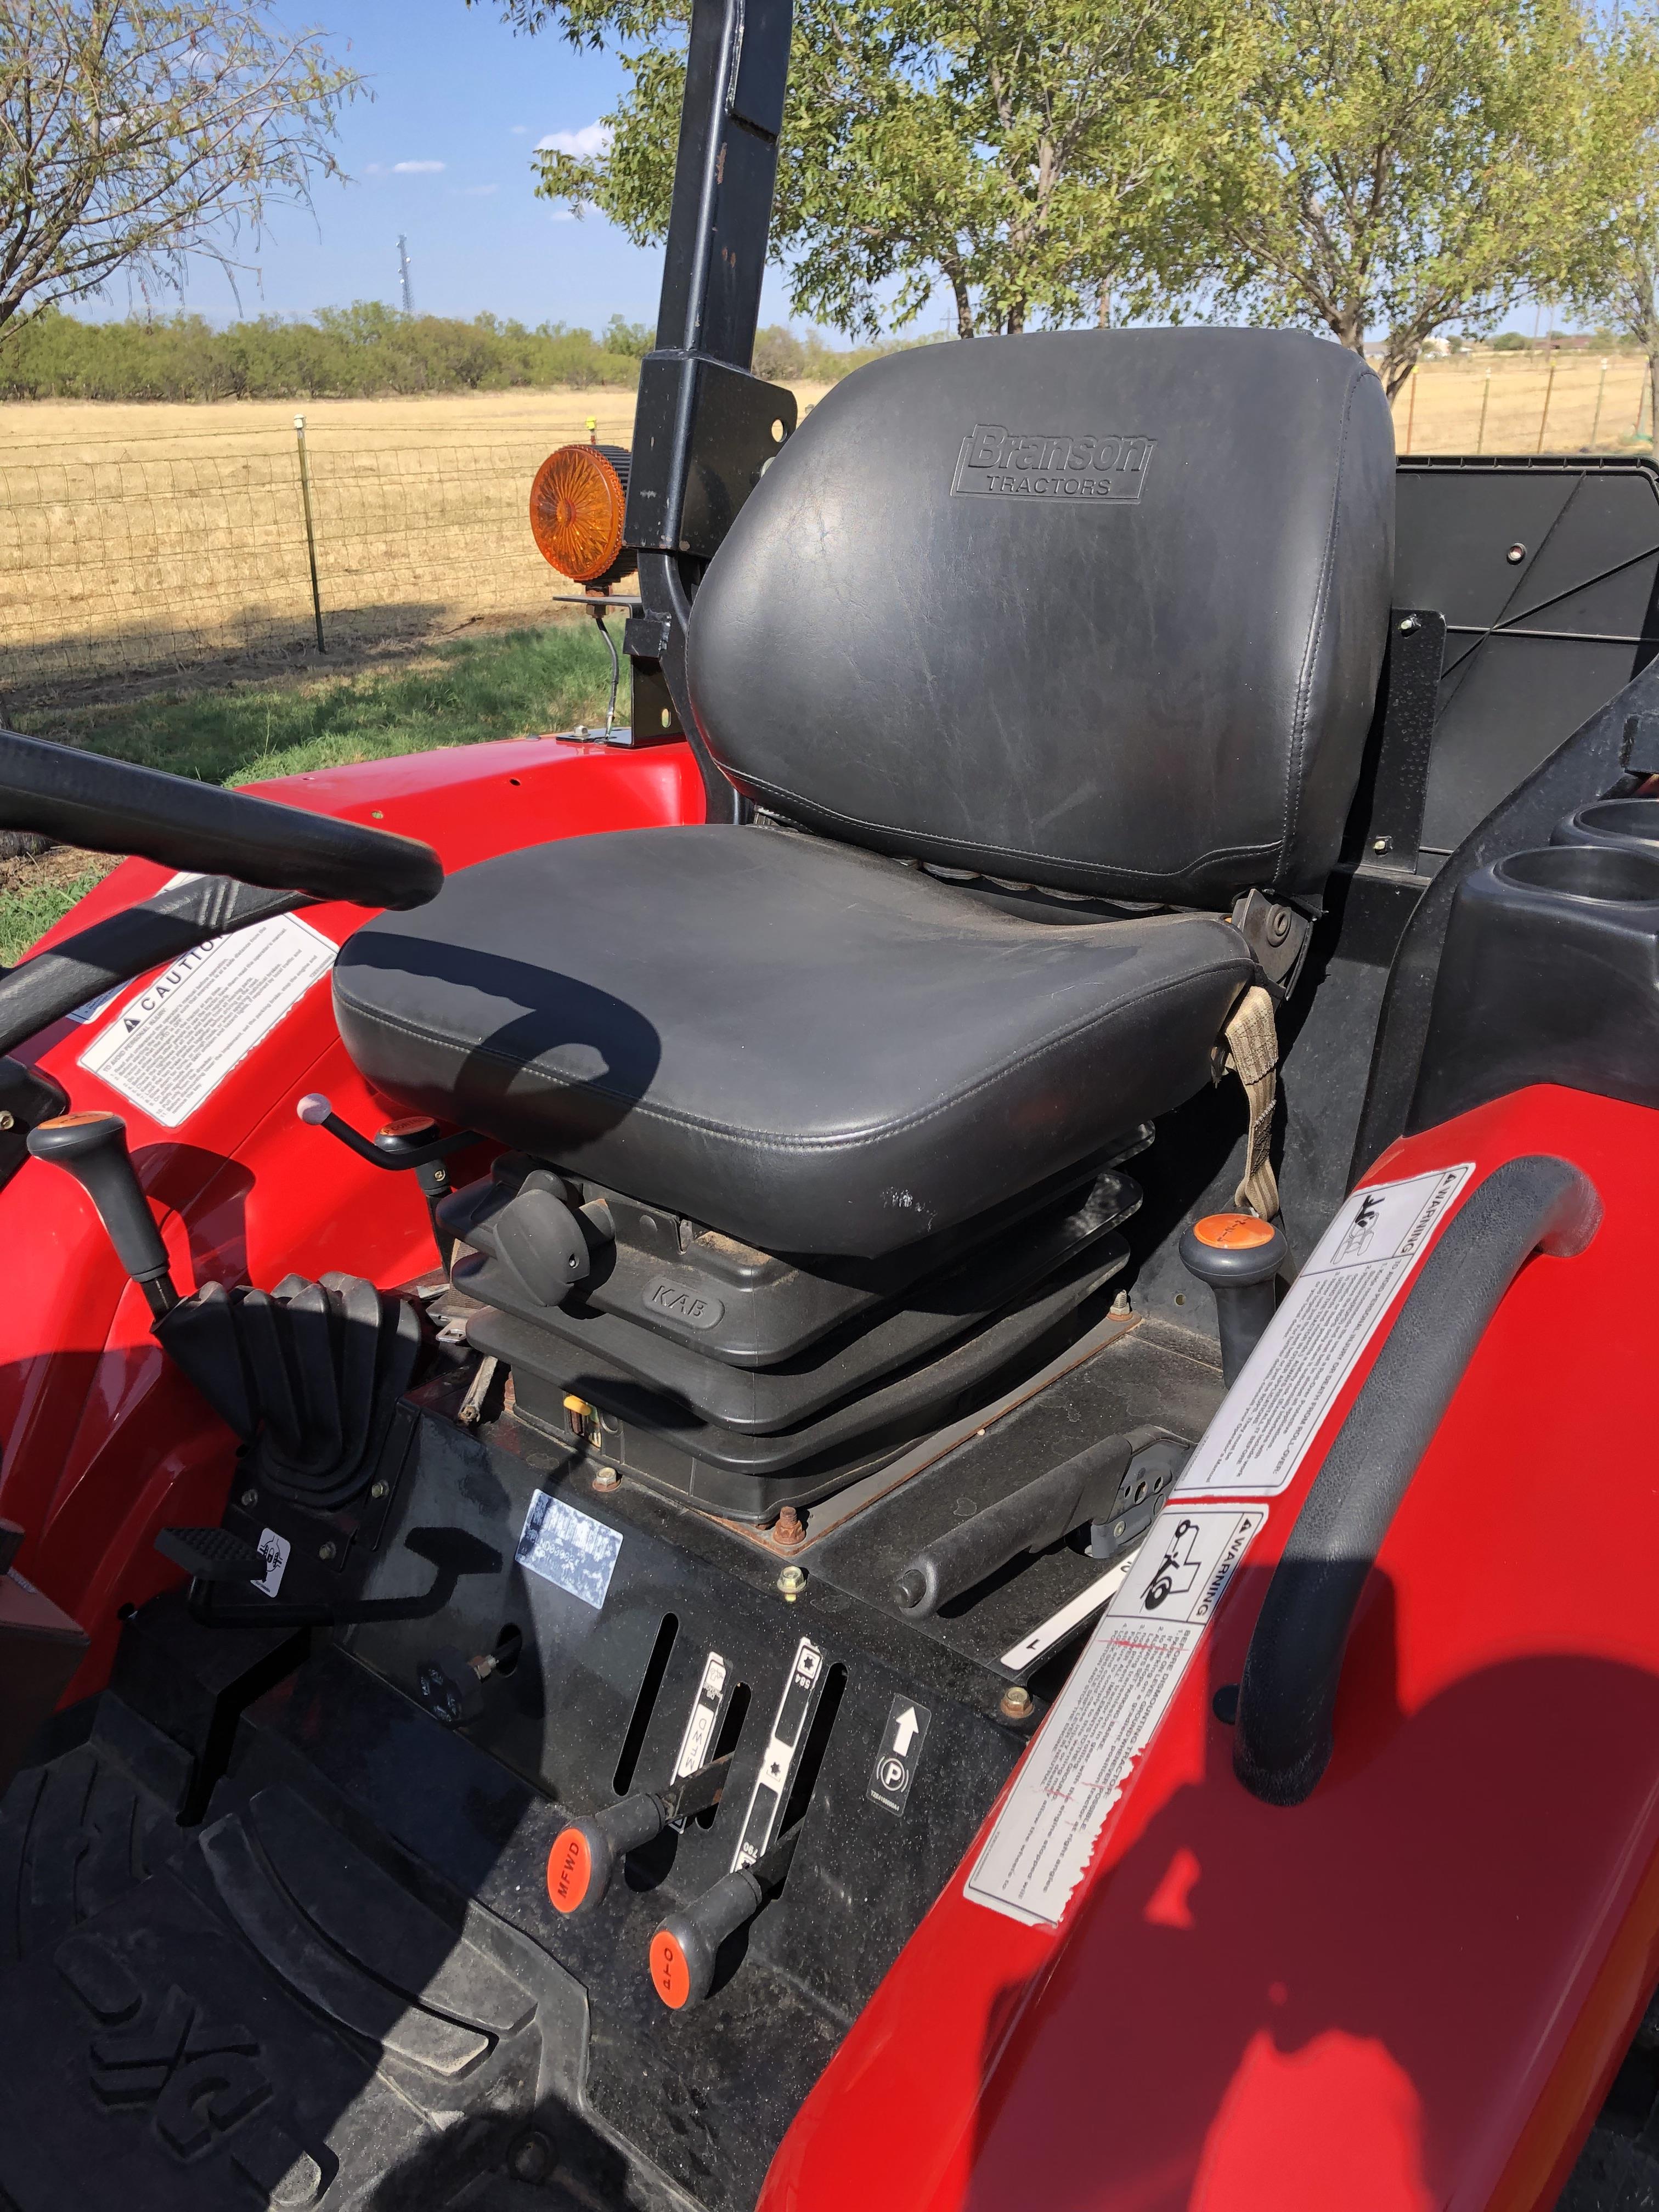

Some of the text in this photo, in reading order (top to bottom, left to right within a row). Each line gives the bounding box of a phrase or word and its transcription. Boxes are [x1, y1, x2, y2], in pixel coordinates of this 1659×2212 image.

[968, 425, 1155, 472] Branson
[987, 475, 1112, 495] TRACTORS
[1400, 1186, 1451, 1252] WARNING
[652, 1284, 706, 1318] KAB
[1272, 1260, 1401, 1473] TO AVOID PERSONAL INJURY OR DEATH FROM ROLL-OVER:
[1195, 1538, 1245, 1615] WARNING
[1106, 1652, 1118, 1667] and
[1147, 1644, 1169, 1677] parking
[1164, 1637, 1179, 1659] PARK
[1114, 1664, 1125, 1678] ALL
[1117, 1651, 1137, 1681] prevent
[1131, 1668, 1143, 1681] SET
[1134, 1664, 1151, 1689] slope.
[1158, 1661, 1167, 1671] ON
[795, 1673, 811, 1690] 584
[1092, 1675, 1113, 1706] comply
[1093, 1670, 1108, 1692] could
[1139, 1681, 1150, 1692] on
[1144, 1674, 1160, 1697] LEVEL
[1077, 1696, 1094, 1721] cause
[1086, 1683, 1115, 1731] IMPLEMENTS
[1100, 1671, 1134, 1728] transmission
[1101, 1685, 1120, 1713] tractor
[1113, 1684, 1134, 1718] PARKING
[1086, 1708, 1095, 1717] to
[1102, 1630, 1191, 1799] BEFORE DISMOUNTING TRACTOR:
[1113, 1703, 1139, 1743] gradient,
[1125, 1701, 1147, 1735] GROUND
[1063, 1724, 1080, 1749] injury
[1076, 1720, 1089, 1735] this
[1080, 1734, 1088, 1743] TO
[1089, 1717, 1103, 1736] from
[686, 1718, 707, 1771] MFWD
[1057, 1752, 1065, 1760] or
[1057, 1740, 1079, 1774] warning
[1071, 1747, 1082, 1760] THE
[1094, 1746, 1117, 1782] position
[1102, 1739, 1128, 1783] WHENEVER
[1072, 1765, 1086, 1784] with
[1063, 1787, 1075, 1802] the
[1077, 1787, 1097, 1818] tractor
[1032, 1800, 1048, 1824] allow
[1046, 1805, 1065, 1837] engine
[1024, 1826, 1035, 1841] the
[1071, 1821, 1080, 1831] at
[743, 1841, 758, 1859] 790
[1059, 1834, 1074, 1856] right
[557, 1842, 579, 1899] MFWD
[1007, 1844, 1026, 1876] wheels
[1026, 1840, 1049, 1879] stopped
[1000, 1880, 1009, 1889] to
[1041, 1859, 1062, 1892] angles
[1017, 1881, 1029, 1898] will
[663, 1948, 673, 1990] PTO
